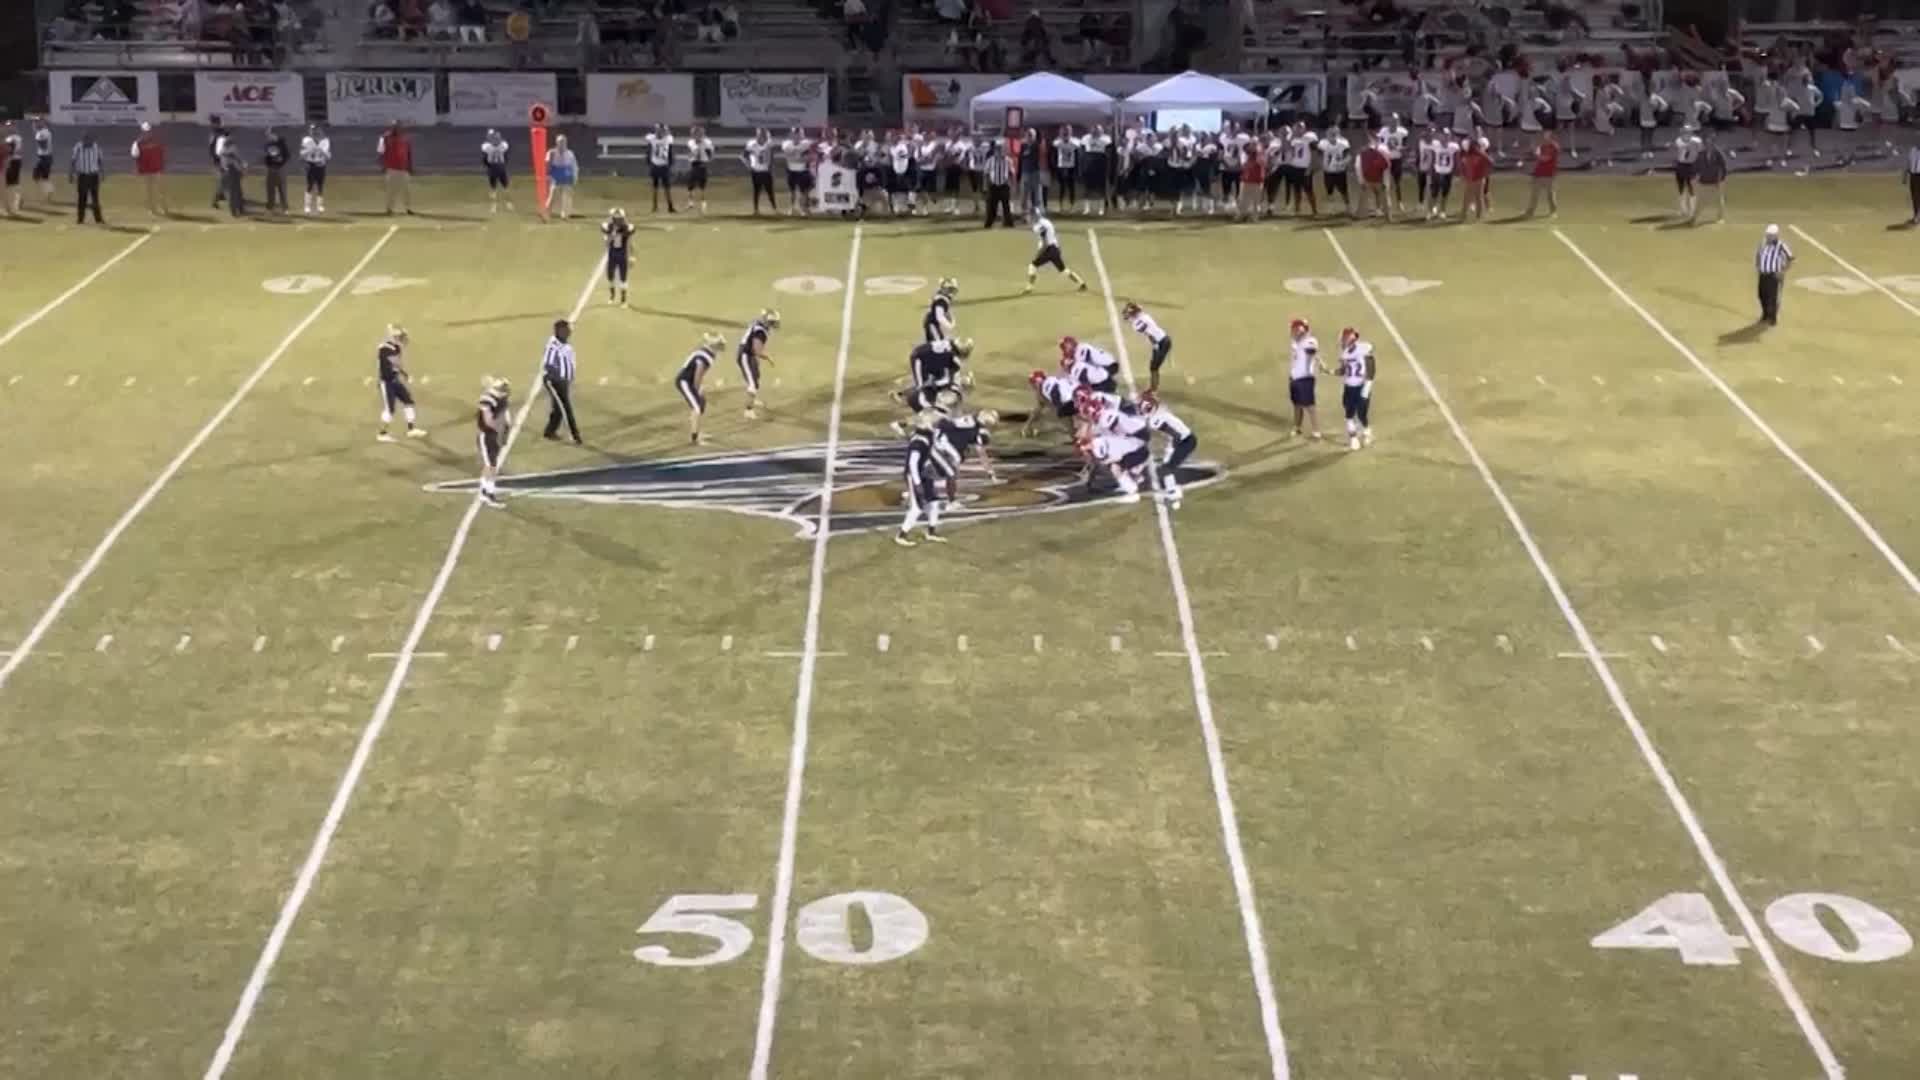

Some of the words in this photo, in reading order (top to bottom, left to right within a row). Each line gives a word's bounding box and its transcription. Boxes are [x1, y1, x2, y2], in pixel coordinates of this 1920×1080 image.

[224, 84, 277, 102] ACE
[633, 890, 930, 966] 50
[1590, 892, 1914, 965] 40
